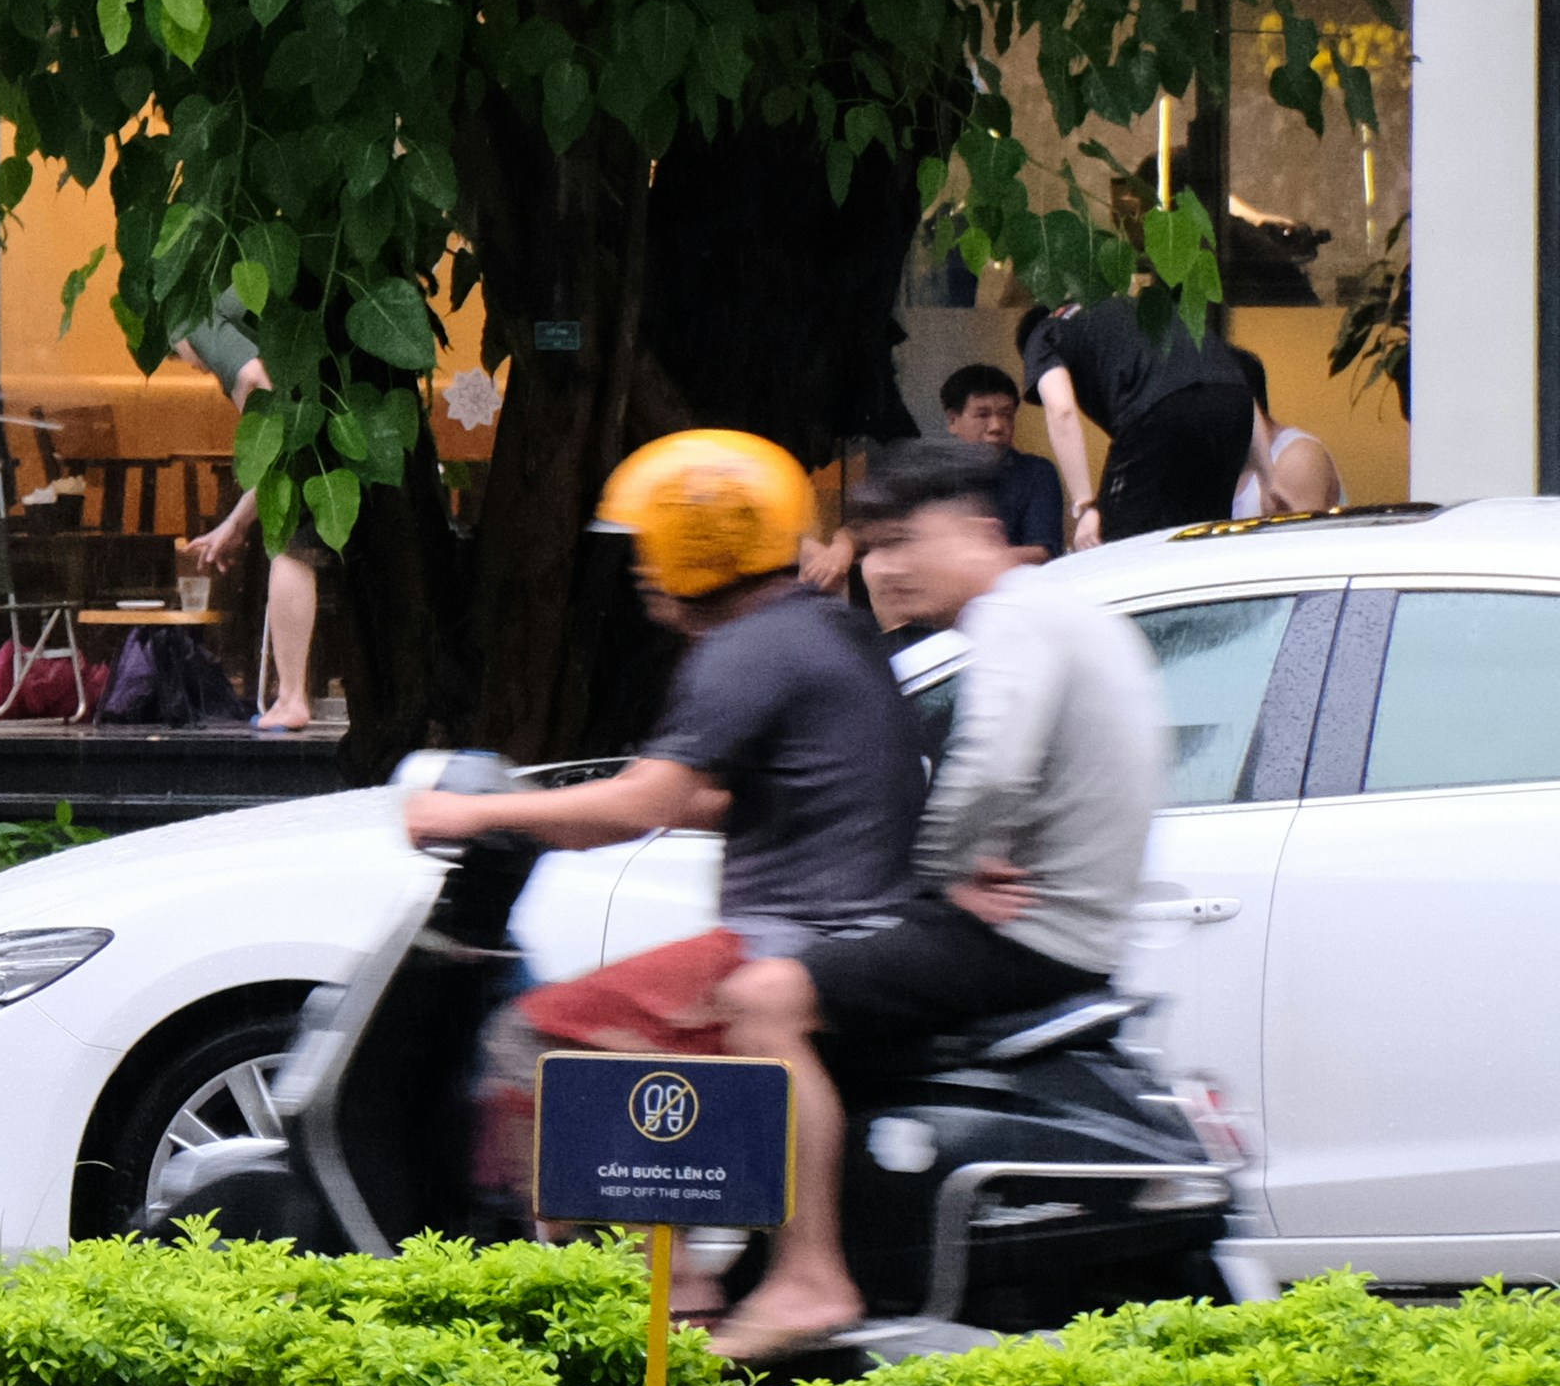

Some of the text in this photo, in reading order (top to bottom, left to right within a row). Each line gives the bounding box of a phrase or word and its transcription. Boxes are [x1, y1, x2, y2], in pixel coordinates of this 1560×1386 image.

[598, 1162, 629, 1178] CẤM
[675, 1165, 703, 1180] LÊN
[601, 1186, 722, 1201] KEEP OFF THE GRASS
